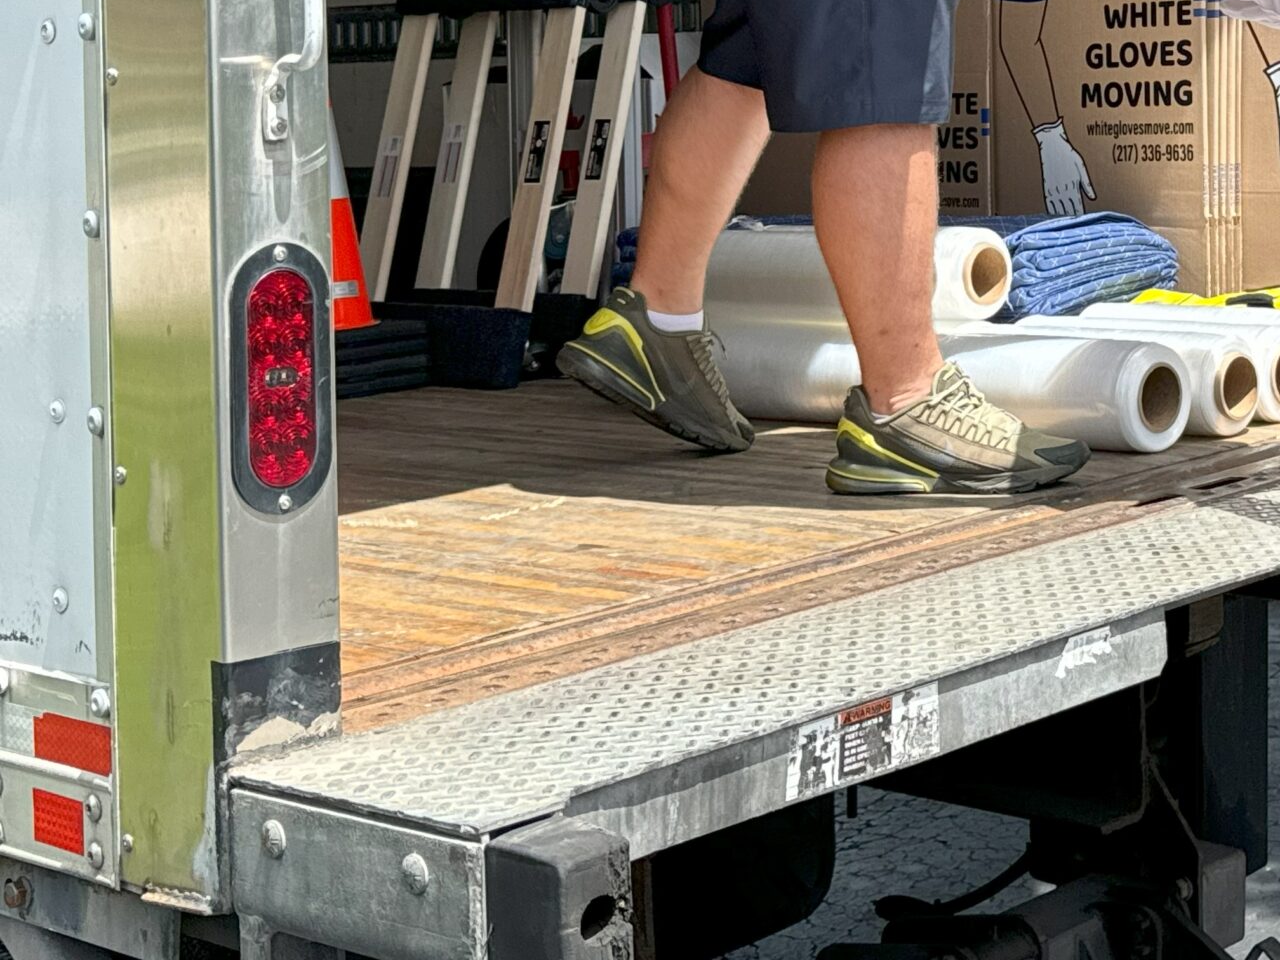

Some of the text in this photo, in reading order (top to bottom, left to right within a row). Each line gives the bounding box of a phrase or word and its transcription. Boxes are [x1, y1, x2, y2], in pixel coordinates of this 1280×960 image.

[1103, 0, 1193, 30] WHITE
[1085, 38, 1193, 70] GLOVES
[1080, 79, 1194, 109] MOVING
[937, 126, 979, 150] VES
[1086, 120, 1194, 139] whiteglovesmove.com
[1112, 143, 1194, 165] (217) 336-9636
[852, 701, 891, 719] WARNING
